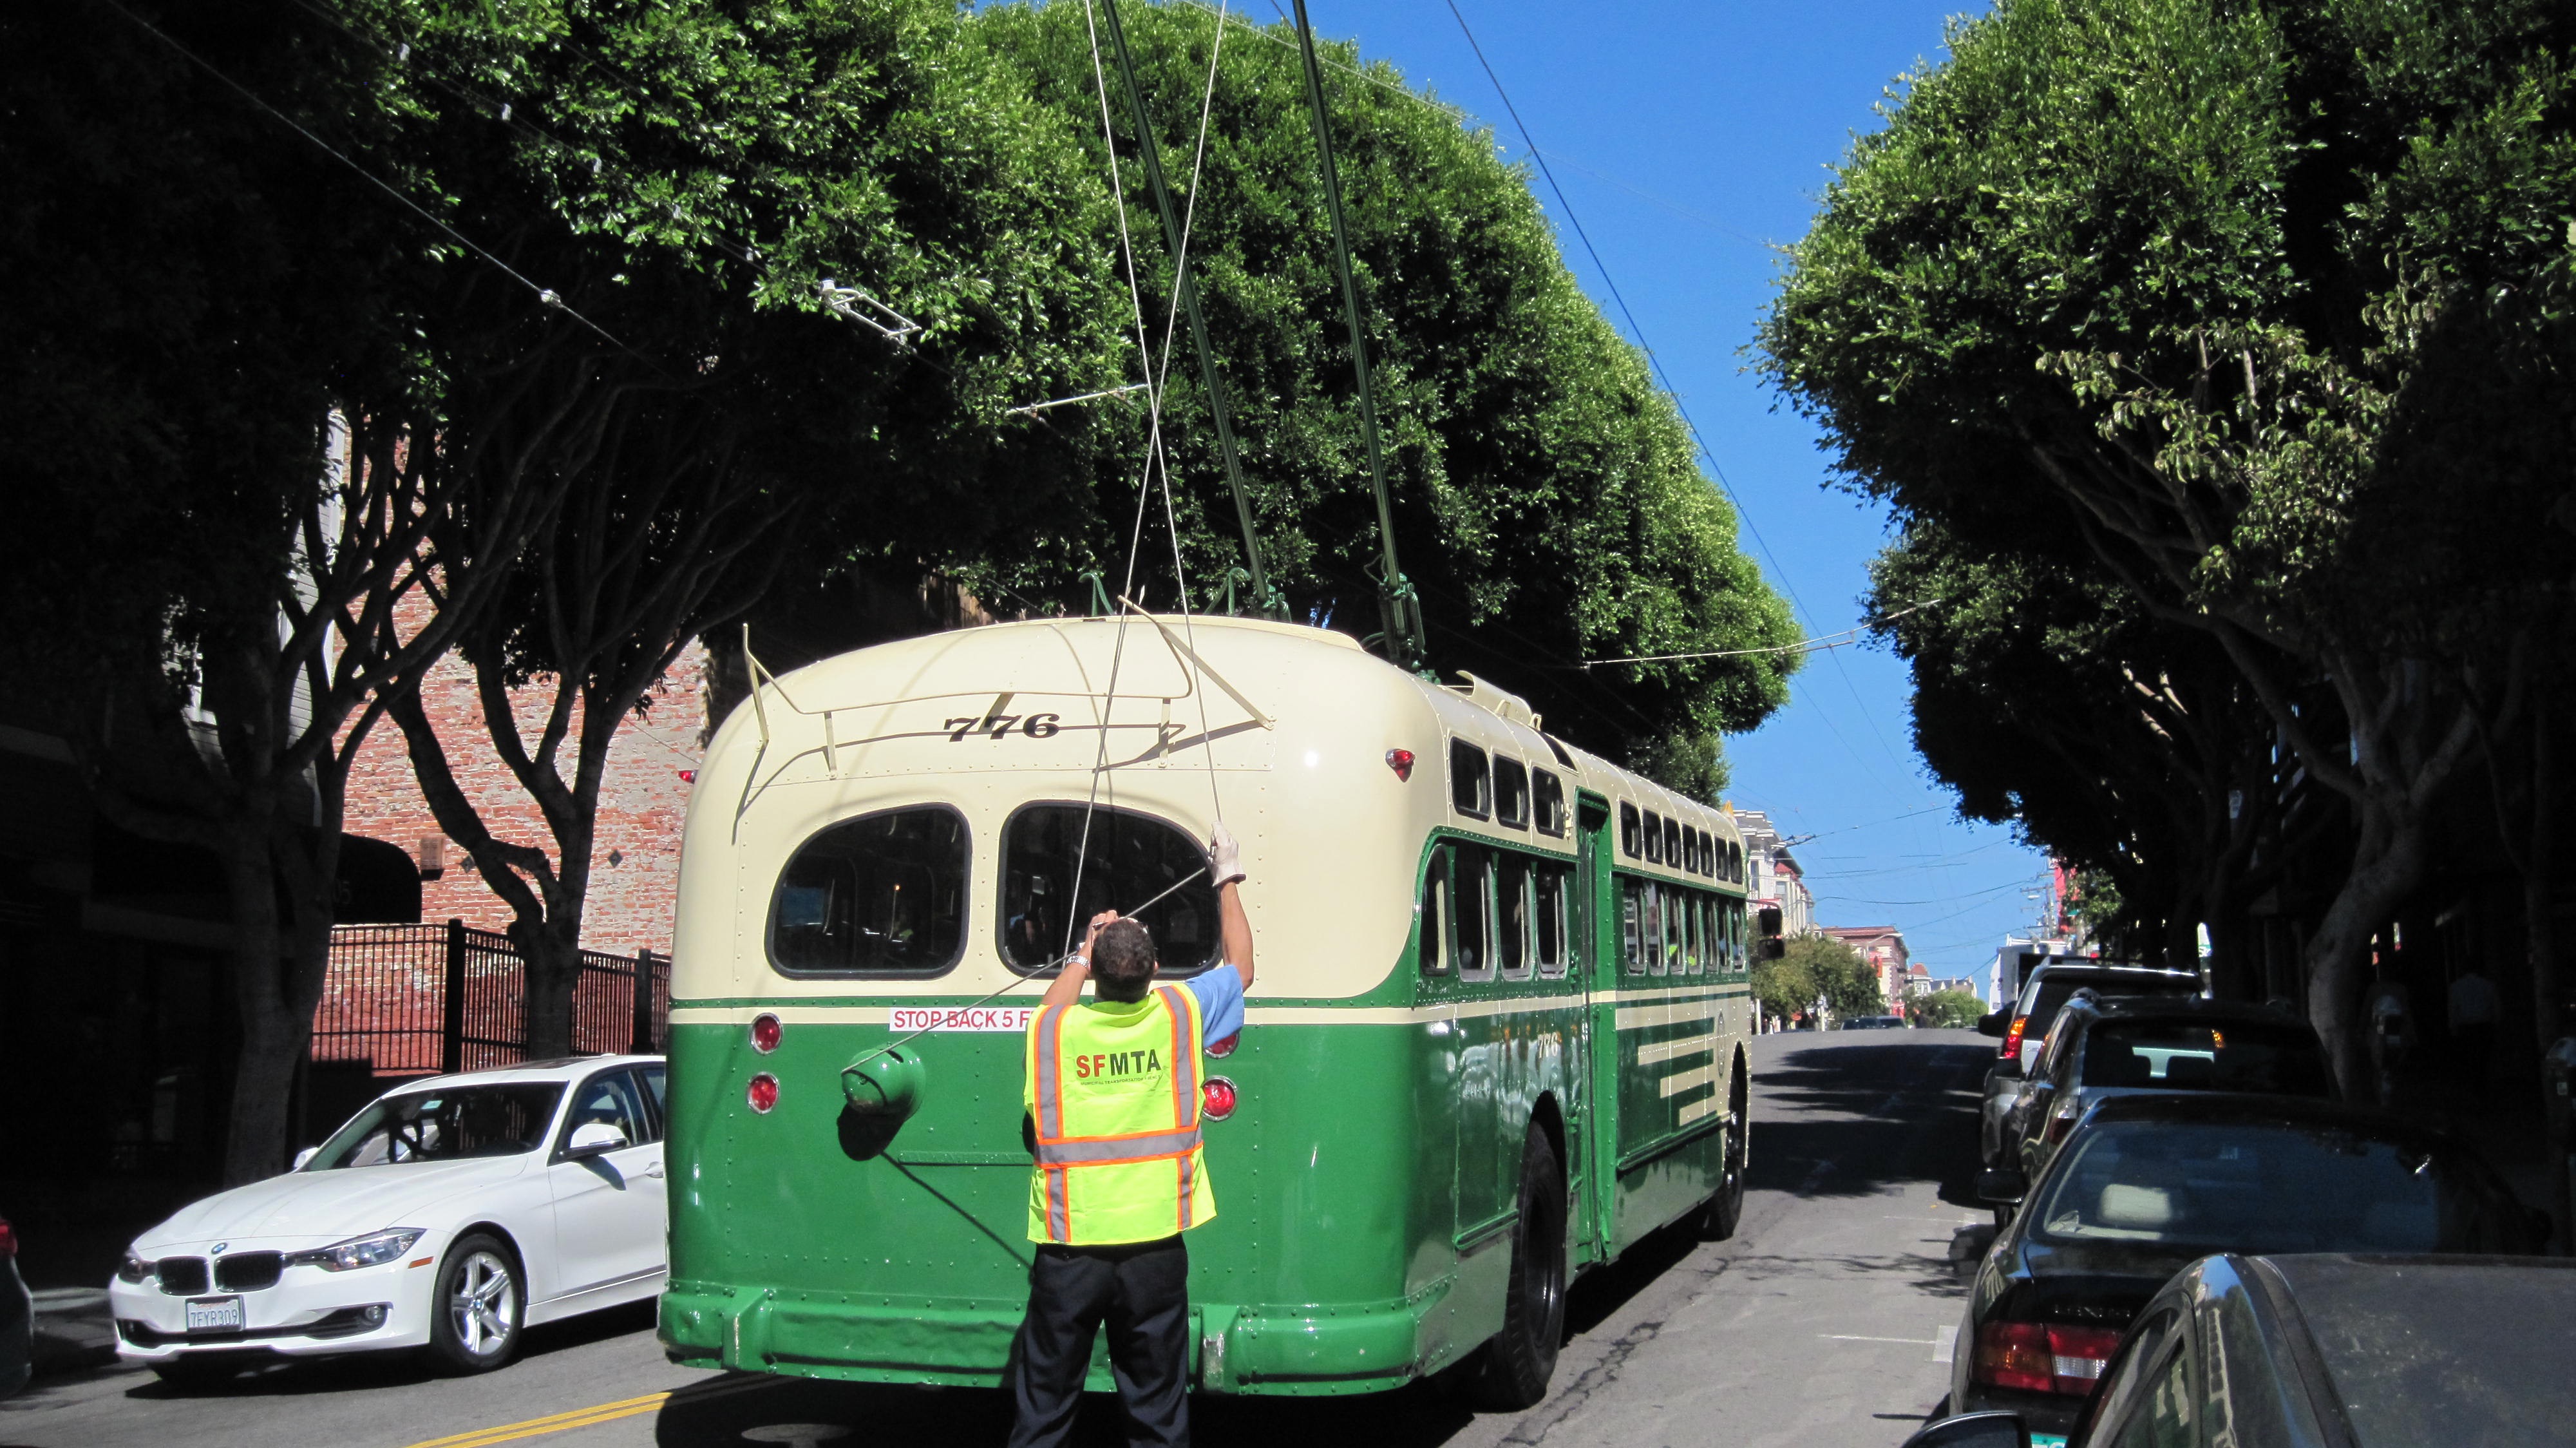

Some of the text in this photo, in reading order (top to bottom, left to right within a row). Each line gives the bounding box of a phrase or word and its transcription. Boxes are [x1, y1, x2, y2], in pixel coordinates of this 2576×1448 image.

[943, 713, 1059, 742] 776
[894, 1010, 942, 1029] STOP
[946, 1009, 998, 1029] BACK
[1001, 1010, 1014, 1029] 5
[1537, 1032, 1558, 1058] 776
[1076, 1049, 1161, 1078] SFMTA
[190, 1308, 238, 1327] 7FYR309
